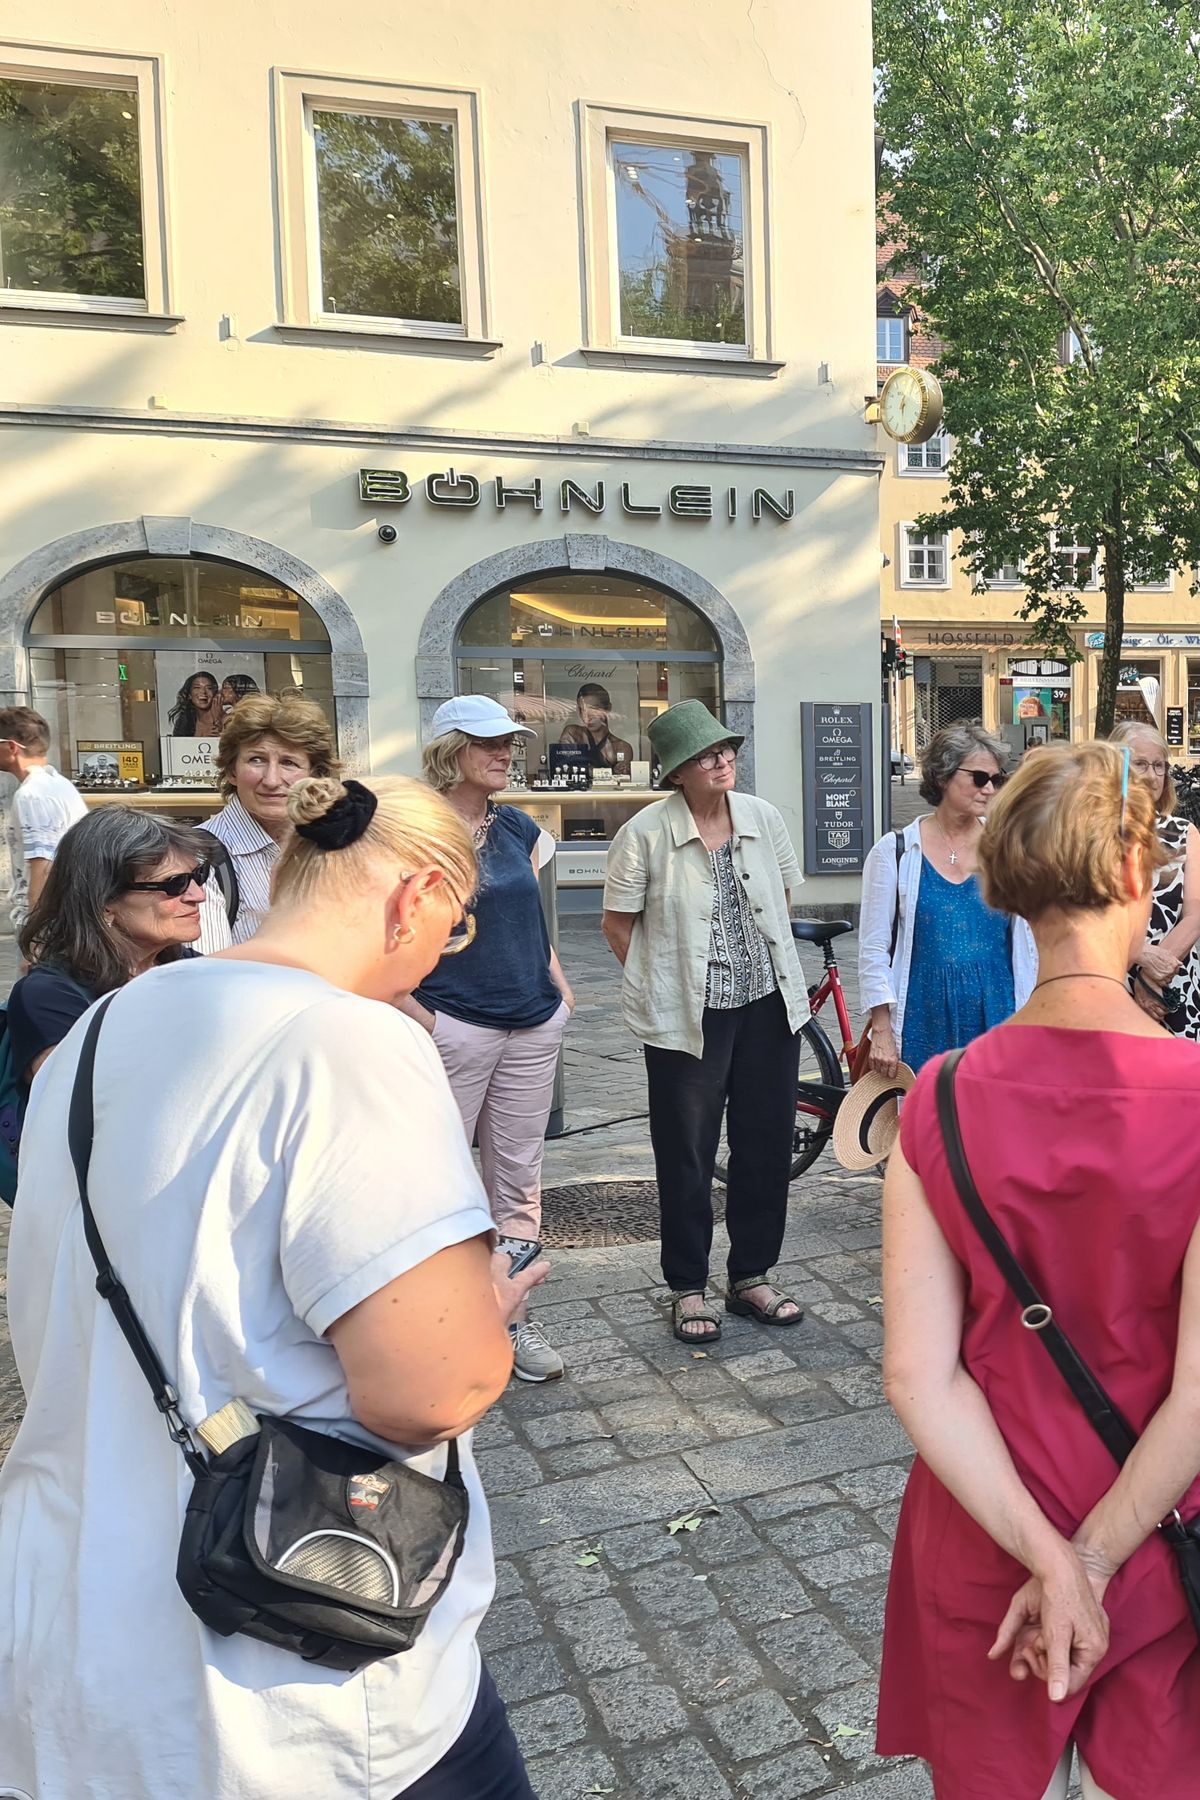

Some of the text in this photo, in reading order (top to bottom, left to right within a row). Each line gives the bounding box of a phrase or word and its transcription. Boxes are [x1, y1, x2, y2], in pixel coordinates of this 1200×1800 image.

[564, 664, 617, 679] Chopard
[821, 716, 853, 724] ROLEX
[822, 736, 853, 744] OMEGA
[181, 754, 212, 764] OME
[821, 772, 856, 785] Chopard
[825, 800, 850, 808] BLANC
